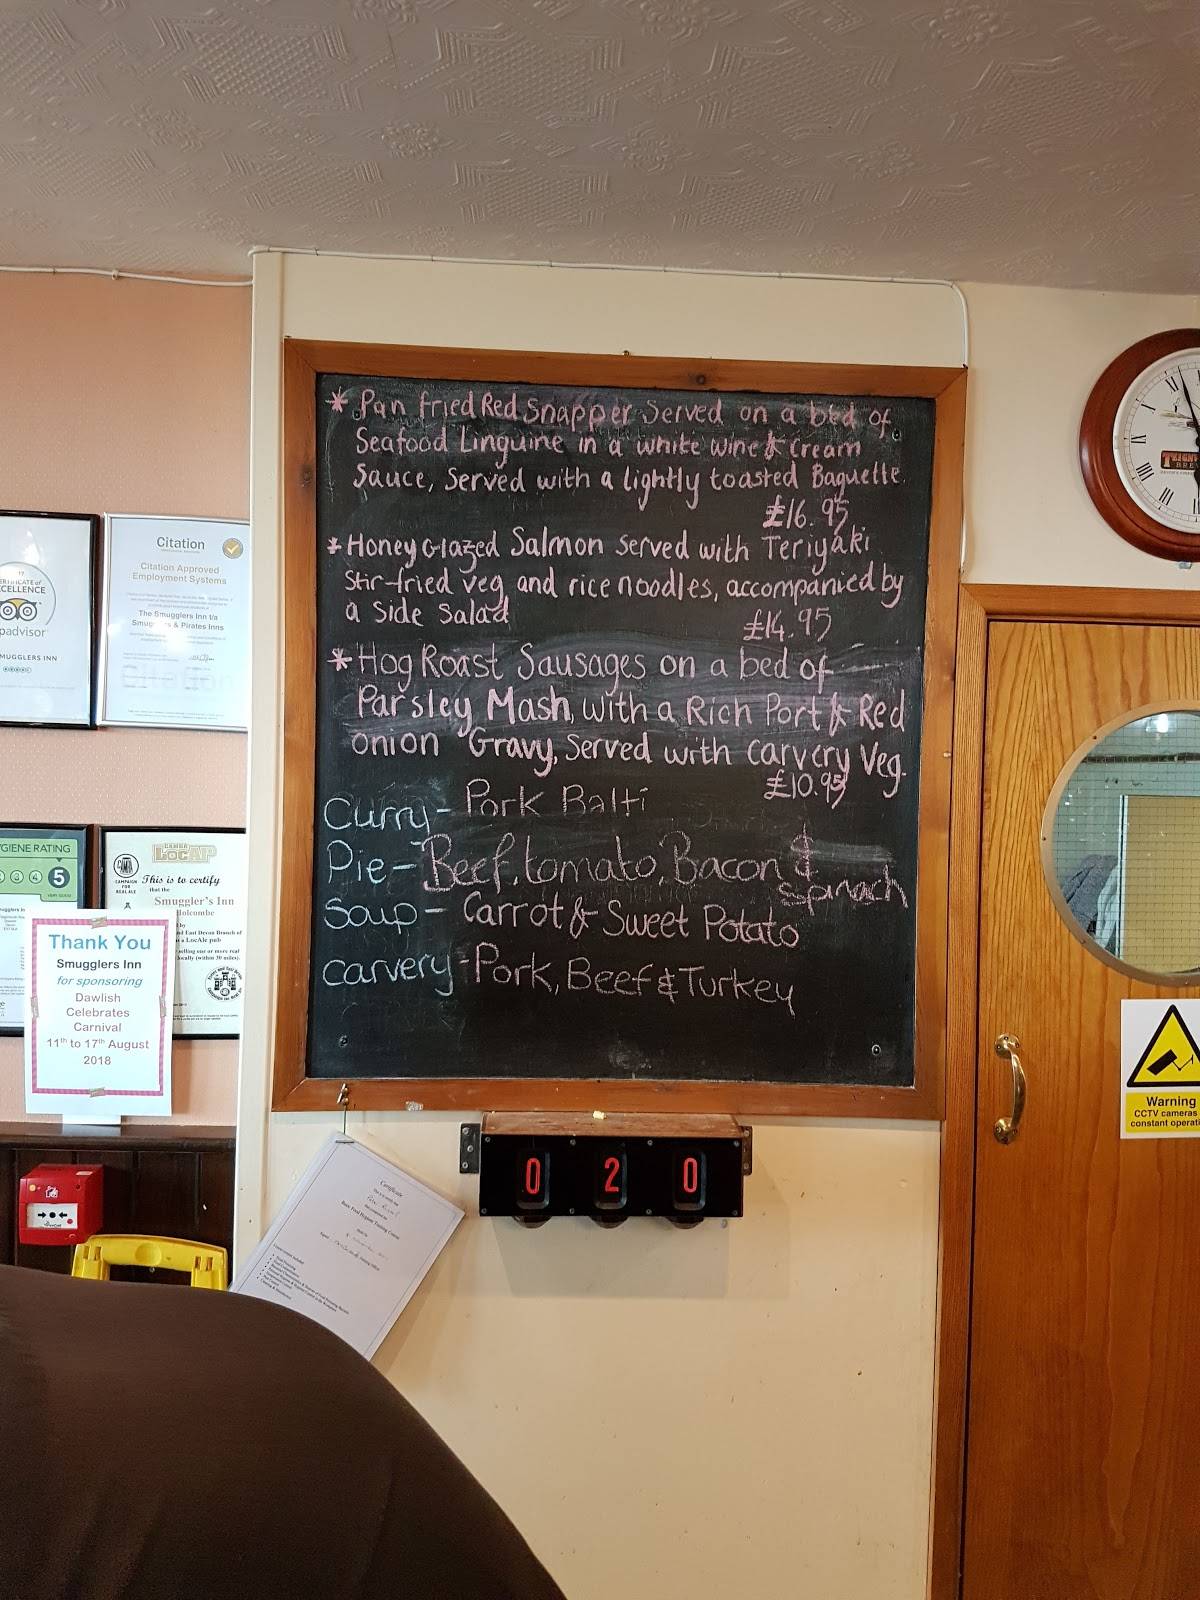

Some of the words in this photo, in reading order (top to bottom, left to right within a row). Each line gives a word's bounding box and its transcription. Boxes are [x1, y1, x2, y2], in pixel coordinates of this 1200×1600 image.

[361, 389, 406, 418] Pan
[419, 390, 477, 421] fried
[481, 391, 518, 420] Red
[524, 395, 630, 432] Snapper
[643, 398, 723, 426] Served
[741, 403, 768, 425] on
[781, 404, 797, 426] a
[810, 401, 857, 430] bed
[869, 407, 891, 439] of
[356, 426, 448, 456] Seafood
[460, 424, 564, 469] Linguine
[579, 432, 597, 454] in
[609, 438, 624, 458] a
[636, 430, 700, 458] white
[710, 434, 758, 458] wine
[353, 463, 434, 493] Sauce,
[536, 466, 590, 490] with
[601, 472, 614, 490] a
[623, 466, 700, 511] lightly
[710, 461, 798, 491] toasted
[762, 494, 850, 535] £16.95
[156, 536, 206, 551] Citation
[347, 532, 417, 568] Honey
[422, 530, 500, 574] Glazed
[511, 526, 603, 558] Salmon
[699, 533, 750, 563] with
[762, 525, 870, 576] Teriyaki
[140, 562, 175, 572] Citation
[176, 564, 220, 574] Approved
[0, 578, 35, 586] ERTIFICATE
[132, 572, 188, 583] Employment
[189, 575, 227, 585] Systems
[517, 566, 558, 599] and
[569, 574, 610, 598] rice
[617, 568, 719, 602] noodles,
[726, 561, 876, 606] accompanied
[881, 562, 904, 608] by
[0, 585, 46, 594] CELLENCE
[154, 610, 194, 620] Smugglers
[195, 612, 208, 620] Inn
[345, 598, 360, 624] a
[0, 626, 46, 637] padvisor
[743, 606, 833, 642] £14.95
[357, 641, 413, 693] Hog
[421, 642, 505, 680] Roast
[517, 642, 646, 698] Sausages
[659, 653, 696, 678] on
[710, 657, 728, 678] a
[740, 646, 791, 681] bed
[799, 654, 834, 694] of
[357, 684, 473, 737] Parsley
[582, 691, 648, 725] with
[657, 700, 677, 723] a
[686, 694, 753, 727] Rich
[766, 692, 821, 731] Port
[828, 692, 853, 737] &
[860, 688, 905, 732] Red
[468, 727, 558, 777] Gravy,
[663, 736, 733, 766] with
[763, 768, 848, 810] £10.95
[465, 778, 545, 818] Pork
[562, 783, 650, 818] Balti
[0, 843, 32, 853] GIENE
[33, 844, 71, 853] RATING
[658, 830, 784, 887] Bacon
[53, 869, 65, 886] 5
[142, 874, 163, 885] This
[166, 875, 174, 884] is
[177, 876, 186, 884] to
[189, 874, 220, 887] certify
[154, 896, 214, 908] Smuggler's
[217, 896, 235, 906] Inn
[463, 890, 565, 929] Carrot
[570, 896, 599, 940] &
[602, 899, 690, 938] Sweet
[702, 904, 801, 948] Potato
[48, 934, 109, 950] Thank
[114, 935, 151, 950] You
[56, 959, 120, 971] Smugglers
[123, 960, 142, 969] Inn
[56, 976, 74, 986] for
[76, 976, 143, 987] sponsoring
[566, 956, 654, 997] Beef
[657, 967, 679, 1005] &
[678, 965, 797, 1020] Turkey
[75, 993, 121, 1003] Dawlish
[66, 1007, 130, 1018] Celebrates
[73, 1022, 122, 1032] Carnival
[46, 1037, 68, 1049] 11th
[70, 1039, 81, 1049] to
[84, 1039, 106, 1049] 17th
[108, 1040, 150, 1051] August
[83, 1056, 112, 1065] 2018
[1146, 1096, 1197, 1109] Warning
[1134, 1109, 1159, 1118] CCTV
[1161, 1110, 1198, 1118] cameras
[1130, 1119, 1168, 1128] constant
[1170, 1119, 1200, 1129] operati
[525, 1158, 541, 1194] 0
[604, 1157, 620, 1193] 2
[683, 1157, 698, 1193] 0
